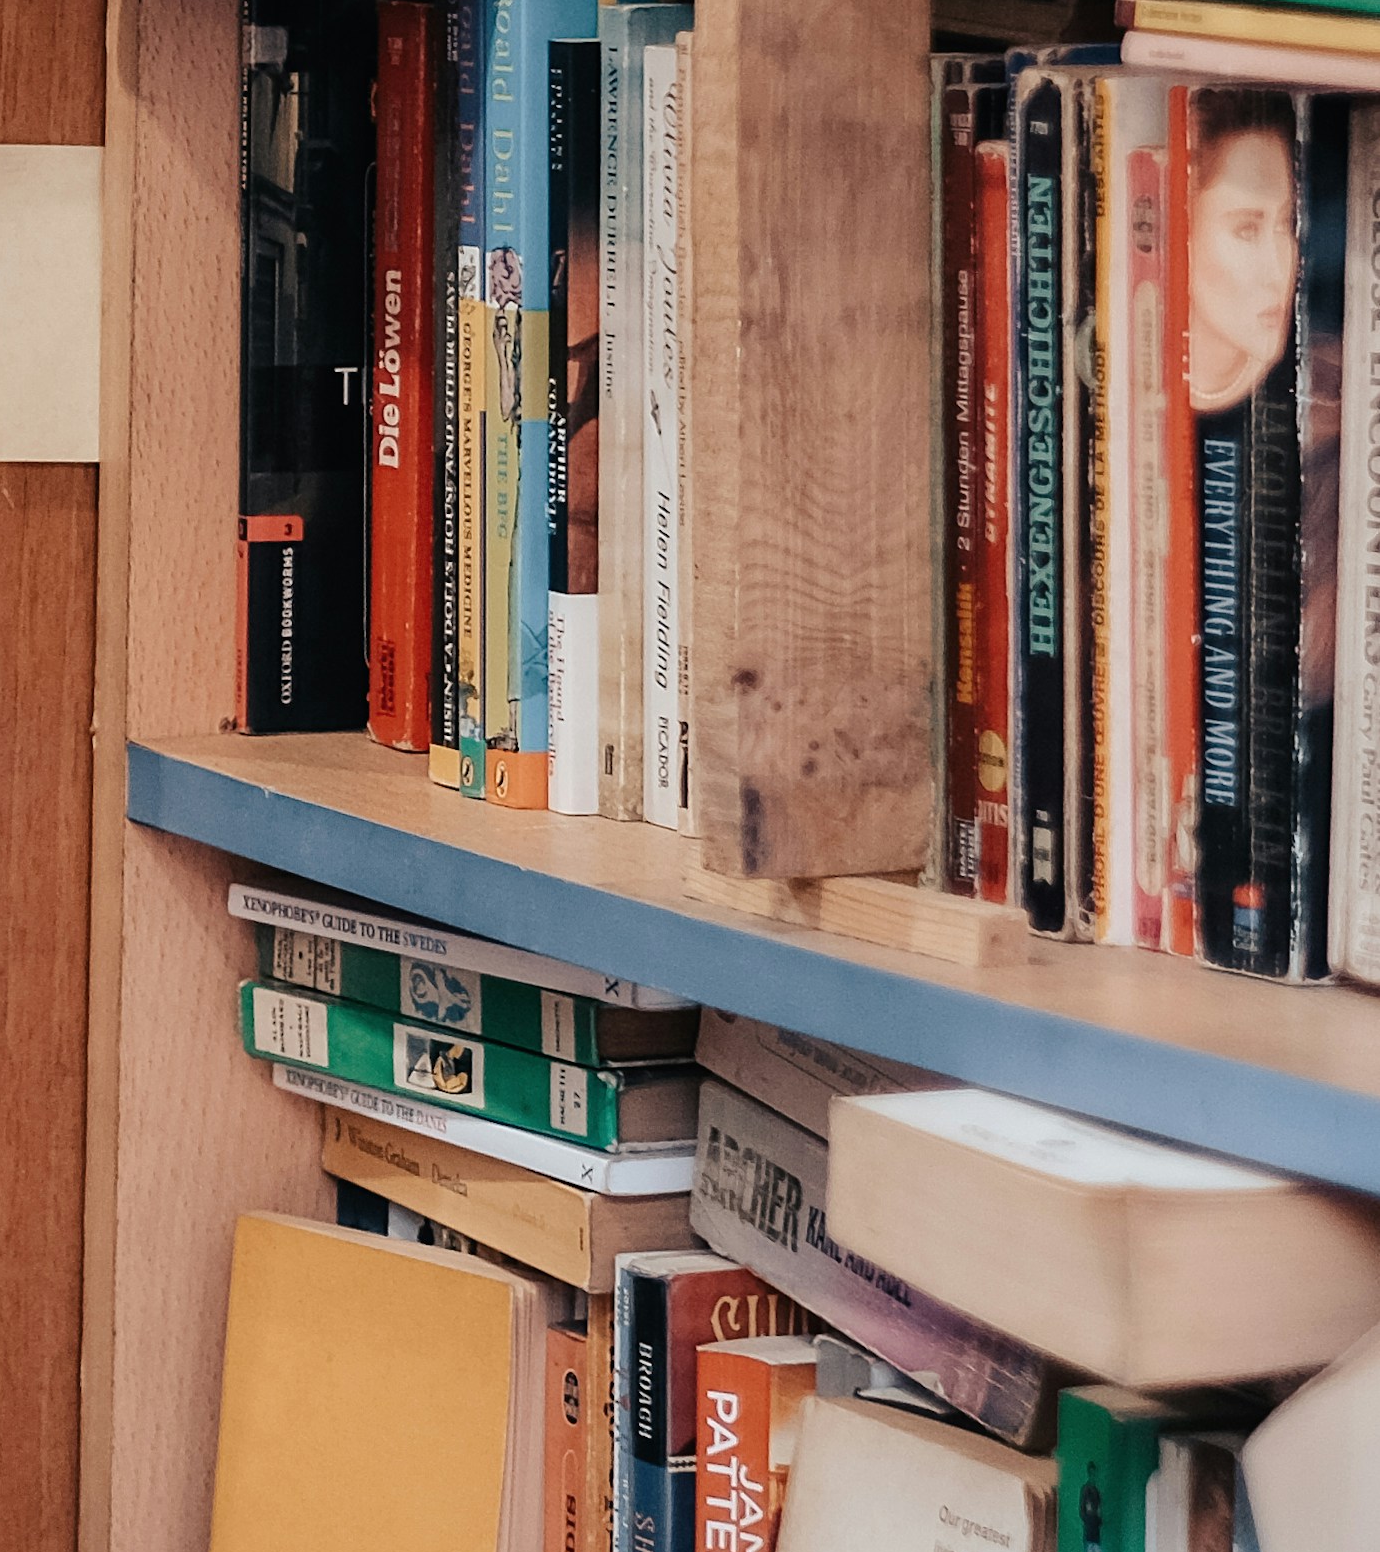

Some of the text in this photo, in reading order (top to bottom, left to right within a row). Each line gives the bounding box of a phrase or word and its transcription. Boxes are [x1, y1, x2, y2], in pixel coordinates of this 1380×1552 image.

[459, 123, 477, 224] Dahl
[491, 129, 516, 233] Dahl
[1094, 94, 1105, 218] DESCARTES
[603, 46, 619, 399] LAWRENCE DURRELL Justine
[378, 269, 402, 470] Die Löwen
[955, 269, 977, 551] 2 Stunden Mittagspause
[1027, 172, 1057, 658] HEXENGESCHICHTEN
[443, 271, 456, 744] IBSEN DOLL'S HOUSE AND OTHER PLAYS
[461, 322, 474, 639] GEORGE'S MARVELLOUS MEDICINE
[495, 434, 510, 540] THE BFG
[546, 378, 557, 537] CONAN DOYLE
[556, 415, 567, 503] ARTHUR
[983, 380, 998, 544] DYNAMITE
[279, 546, 294, 705] OXFORD BOOKWORMS
[653, 491, 671, 690] Helen Fielding
[955, 582, 976, 703] Konsalik
[1201, 438, 1238, 807] EVERYTHING AND MORE
[556, 657, 566, 722] Hound
[656, 716, 669, 789] PICADOR
[322, 912, 357, 936] GUIDE
[360, 921, 375, 939] TO
[377, 925, 401, 944] THE
[403, 930, 448, 956] SWEDES
[350, 1089, 379, 1112] GUIDE
[381, 1098, 394, 1115] TO
[395, 1101, 414, 1122] THE
[705, 1125, 803, 1253] ARCHER
[637, 1343, 654, 1440] BROACH
[939, 1503, 1011, 1550] Our greatest
